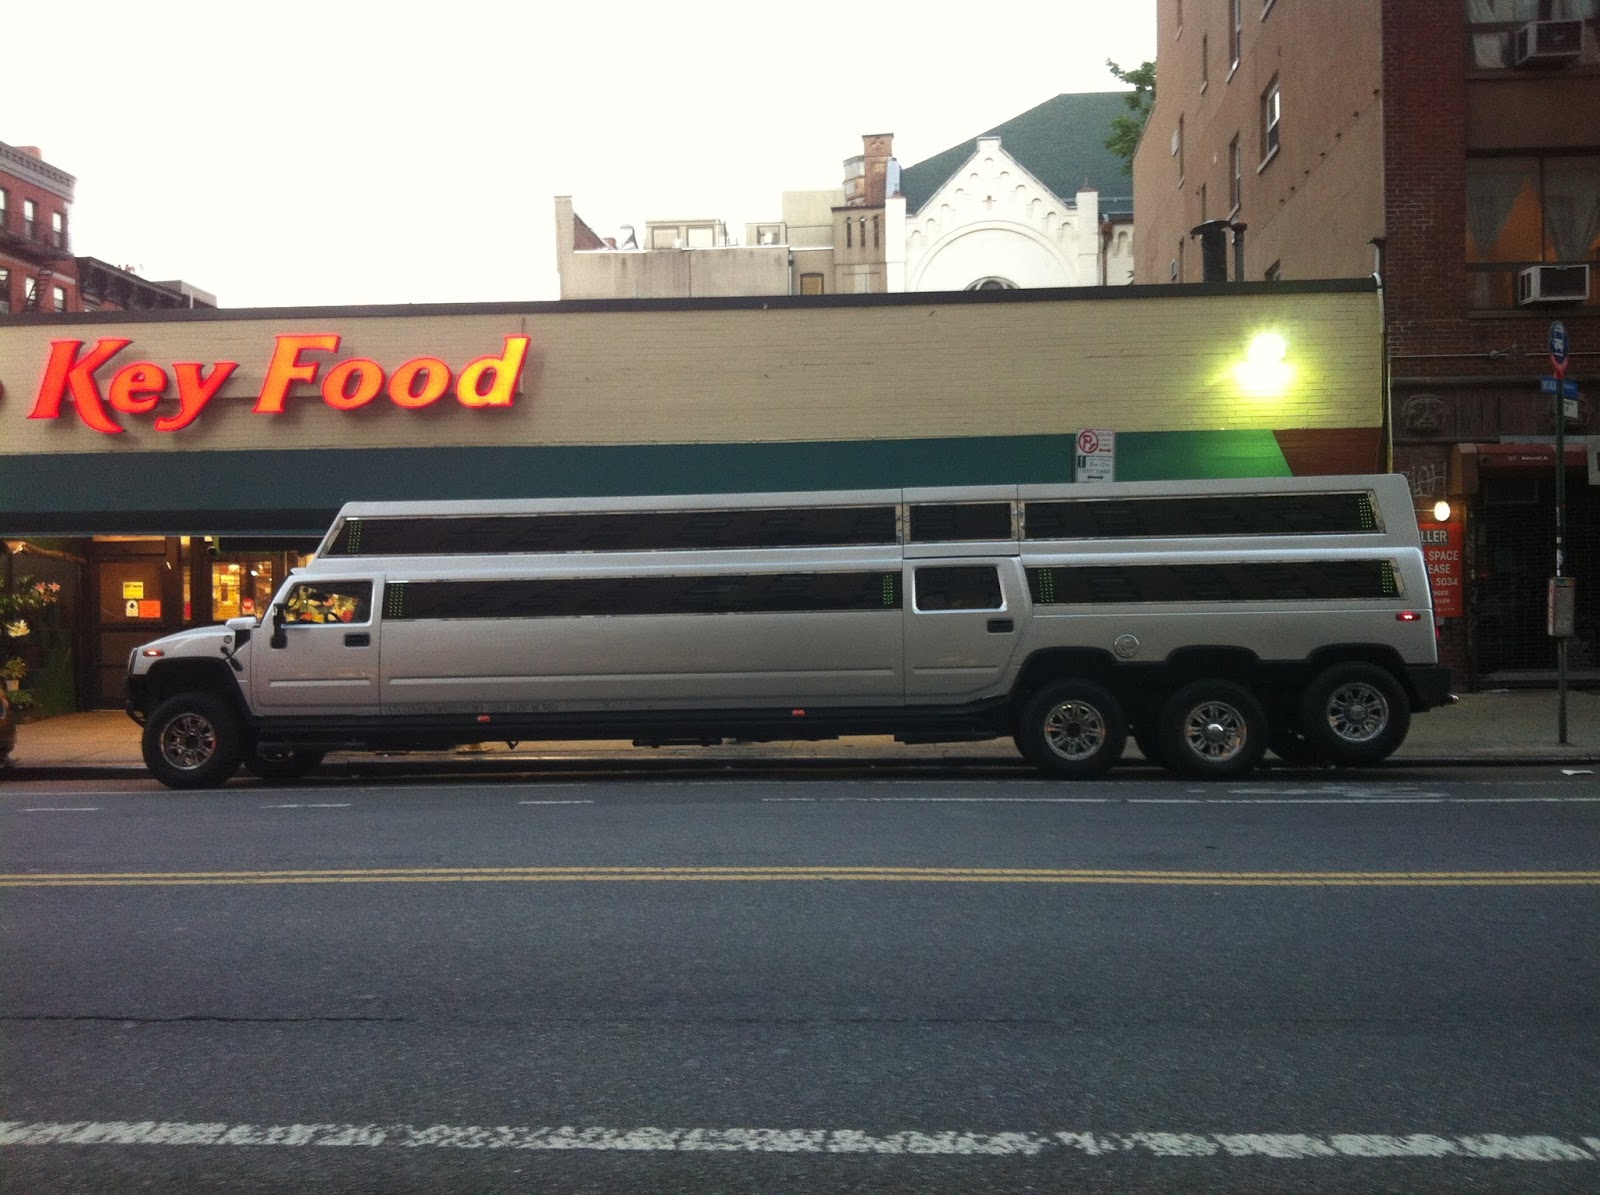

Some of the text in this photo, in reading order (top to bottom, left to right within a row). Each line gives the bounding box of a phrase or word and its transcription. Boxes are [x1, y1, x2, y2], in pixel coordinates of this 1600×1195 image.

[27, 334, 531, 434] Key Food
[1420, 530, 1448, 543] LLER
[1428, 550, 1459, 561] SPACE
[1429, 563, 1451, 574] EASE
[1436, 577, 1458, 586] 5034
